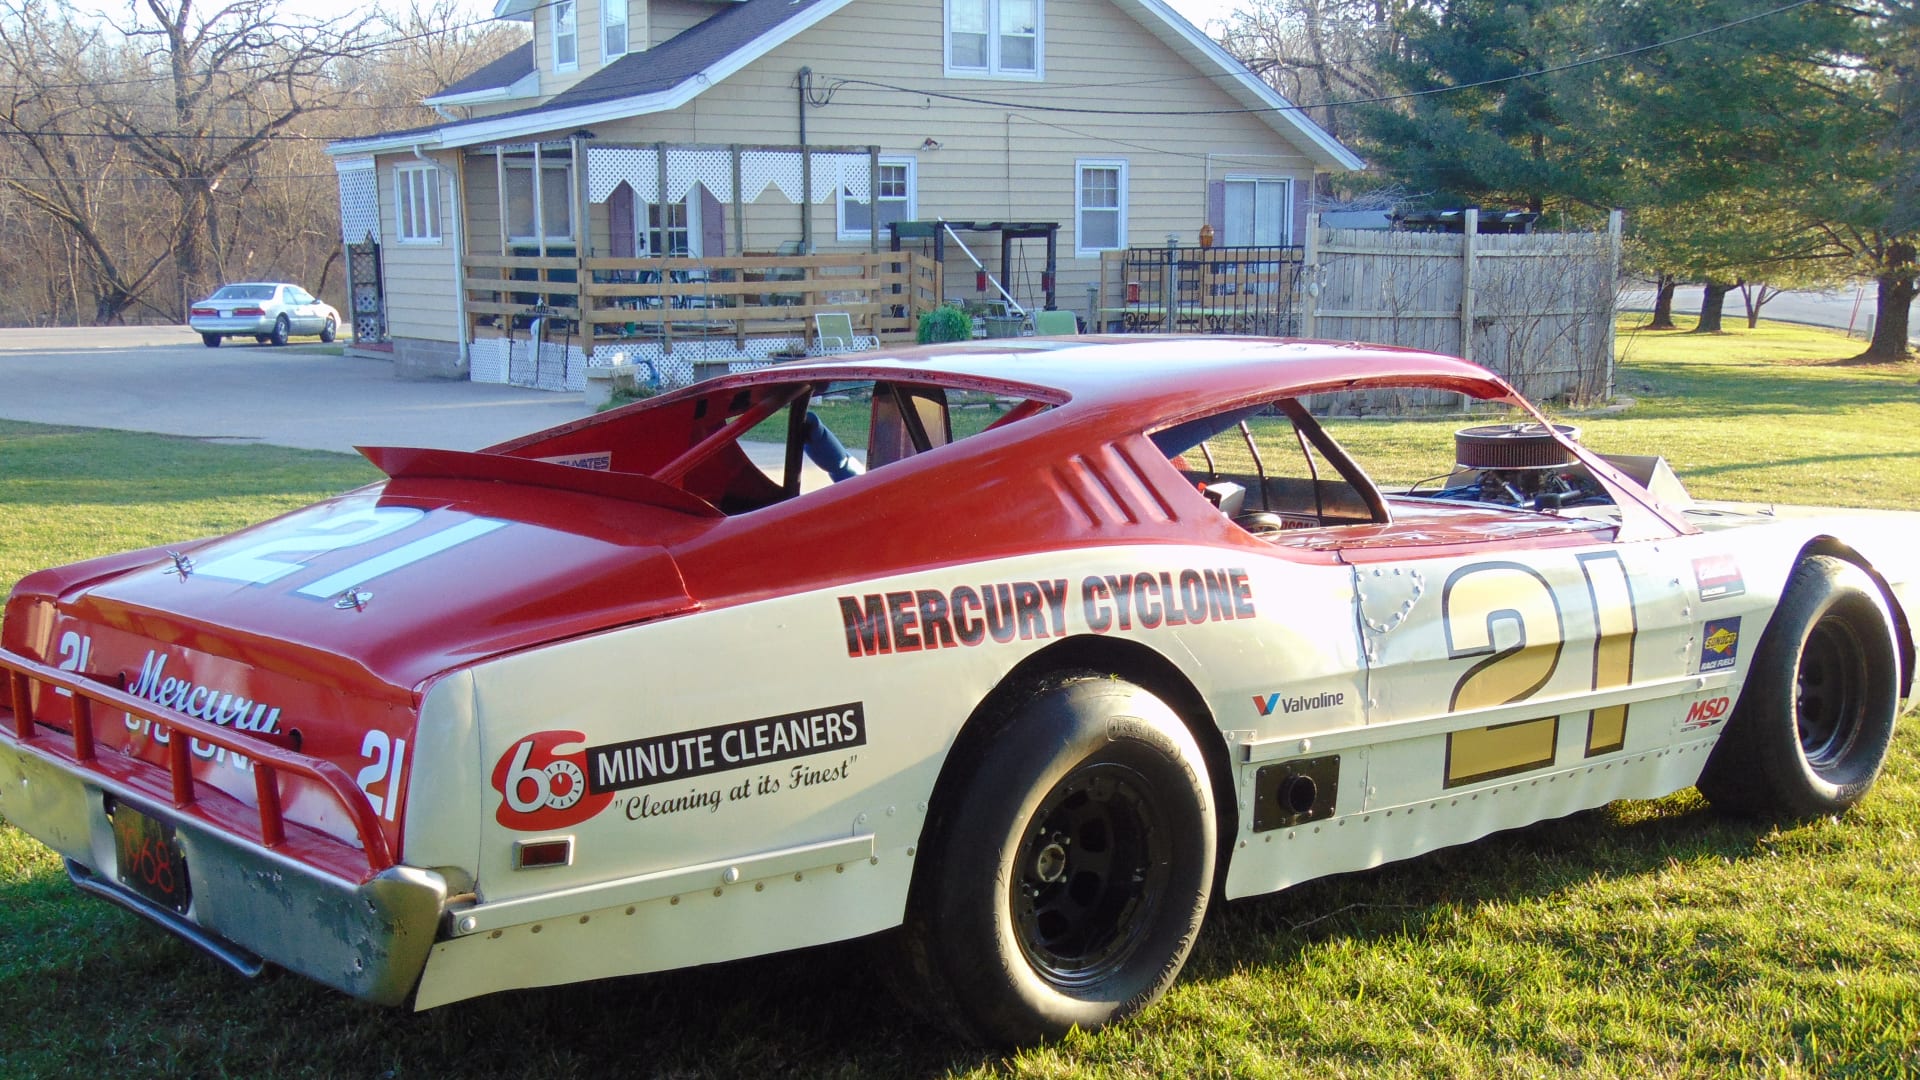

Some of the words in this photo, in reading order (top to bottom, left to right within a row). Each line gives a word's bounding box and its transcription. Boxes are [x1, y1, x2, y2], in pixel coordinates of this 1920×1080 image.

[193, 505, 513, 599] 21
[837, 578, 1069, 658] MERCURY
[1080, 567, 1257, 635] CYCLONE
[1705, 633, 1737, 648] SUNOCO
[55, 631, 91, 698] 21
[128, 649, 281, 735] Mercury
[1441, 549, 1637, 790] 21
[1701, 661, 1717, 670] RACE
[1717, 657, 1735, 667] FUELS
[1282, 691, 1344, 714] Valvoline
[1684, 696, 1730, 723] MSD
[356, 729, 406, 822] 21
[505, 740, 585, 813] 60
[598, 734, 715, 786] MINUTE
[720, 709, 858, 763] CLEANERS
[614, 786, 723, 822] "Cleaning
[729, 777, 751, 802] at
[757, 774, 780, 797] its
[789, 755, 858, 790] Finest"
[117, 821, 175, 894] 1968
